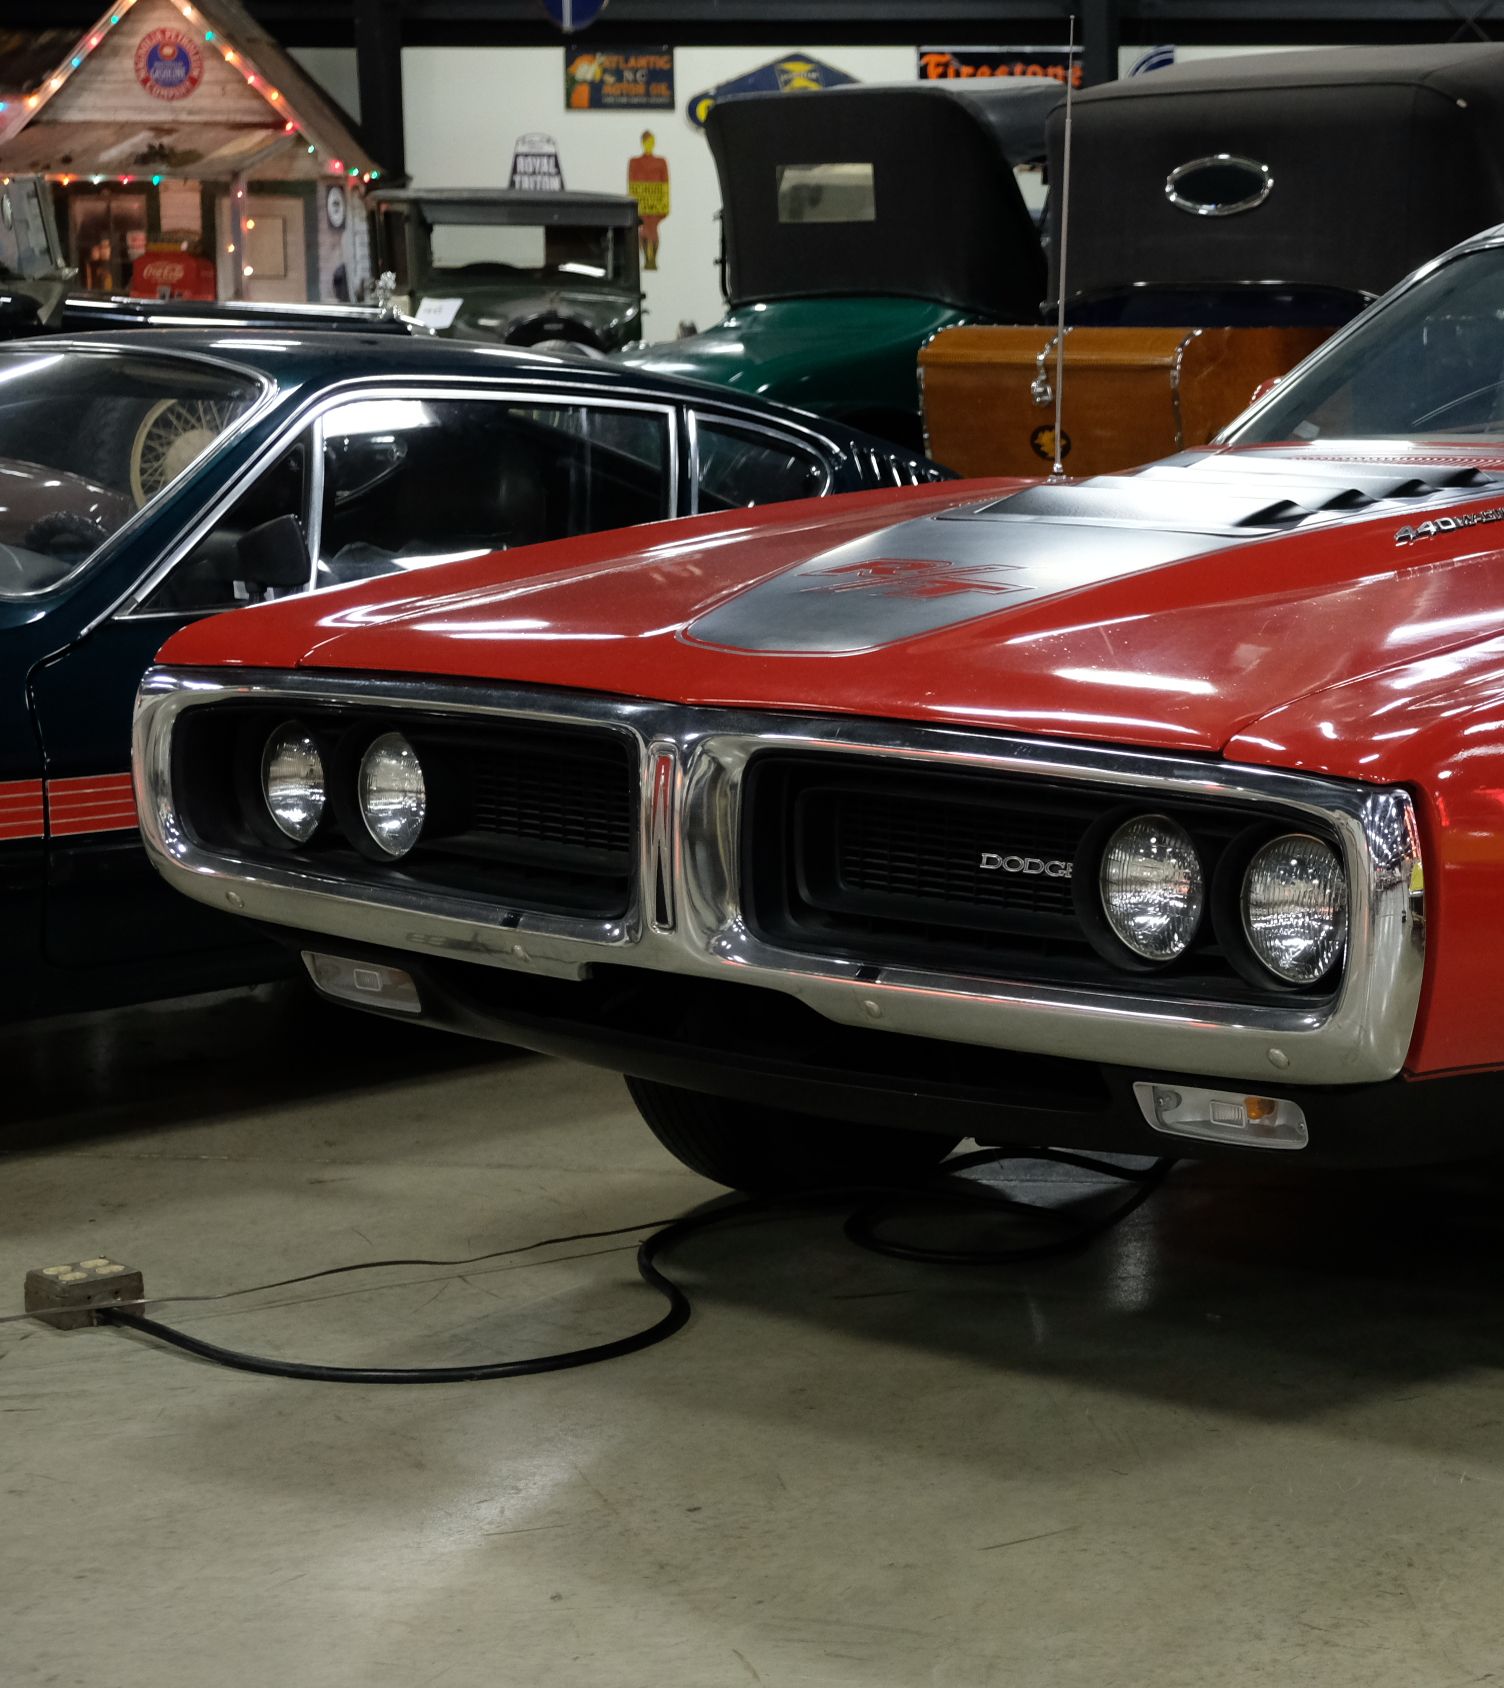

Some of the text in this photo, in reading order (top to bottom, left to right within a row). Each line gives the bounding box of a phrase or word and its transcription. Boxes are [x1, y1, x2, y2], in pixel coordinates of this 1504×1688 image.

[602, 54, 672, 70] ATLANTIC
[919, 53, 1083, 89] Firestone
[602, 82, 646, 96] MOTOR
[517, 155, 557, 174] ROYAL
[513, 175, 560, 191] TRITON
[1393, 516, 1458, 543] 440
